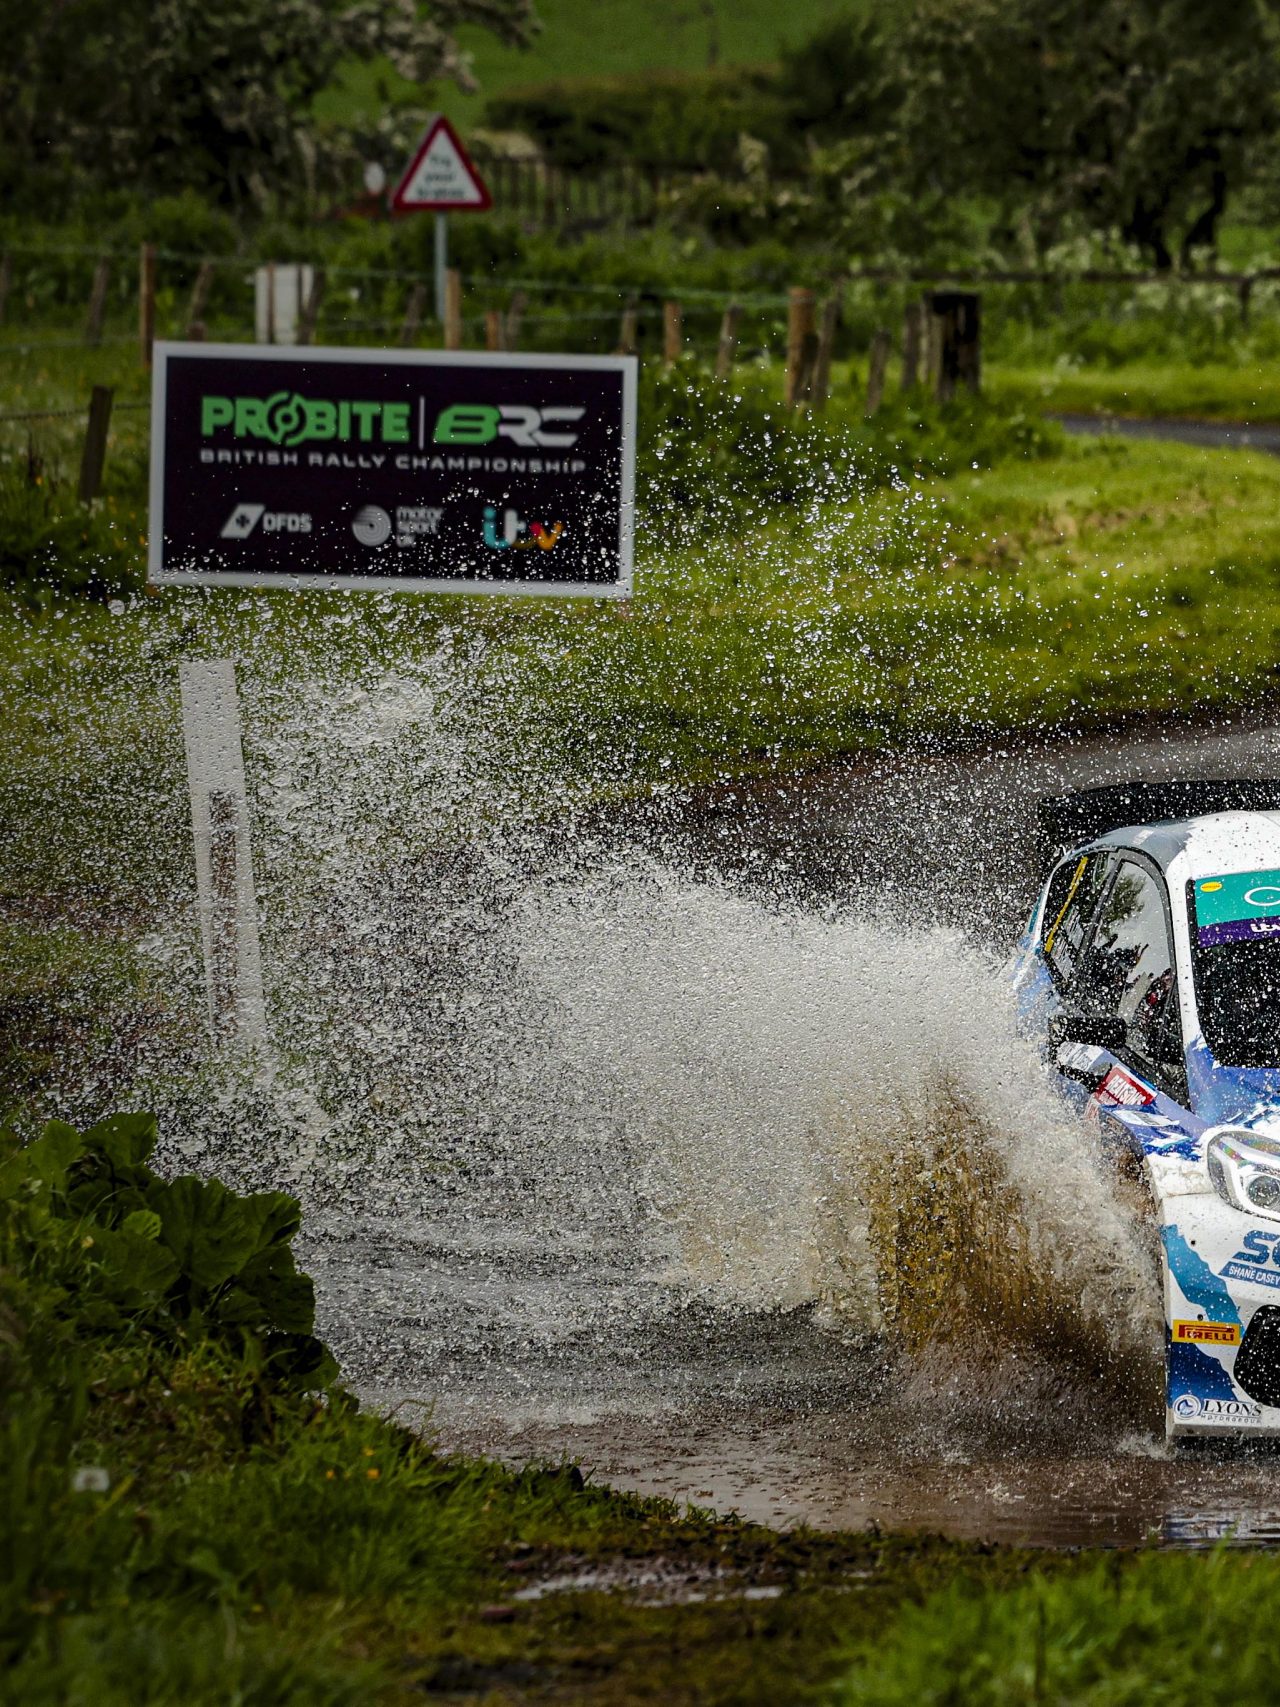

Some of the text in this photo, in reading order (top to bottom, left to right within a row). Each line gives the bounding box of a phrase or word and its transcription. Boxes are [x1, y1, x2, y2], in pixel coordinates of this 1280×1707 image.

[202, 391, 587, 447] PROBITE BRC
[200, 449, 587, 474] BRITISH RALLY CHAMPIONSHIP
[483, 506, 563, 551] itv
[1228, 1265, 1255, 1281] SHANE
[1255, 1271, 1280, 1288] CASEY
[1178, 1324, 1234, 1341] PIRELLI
[1204, 1400, 1262, 1417] LYONS
